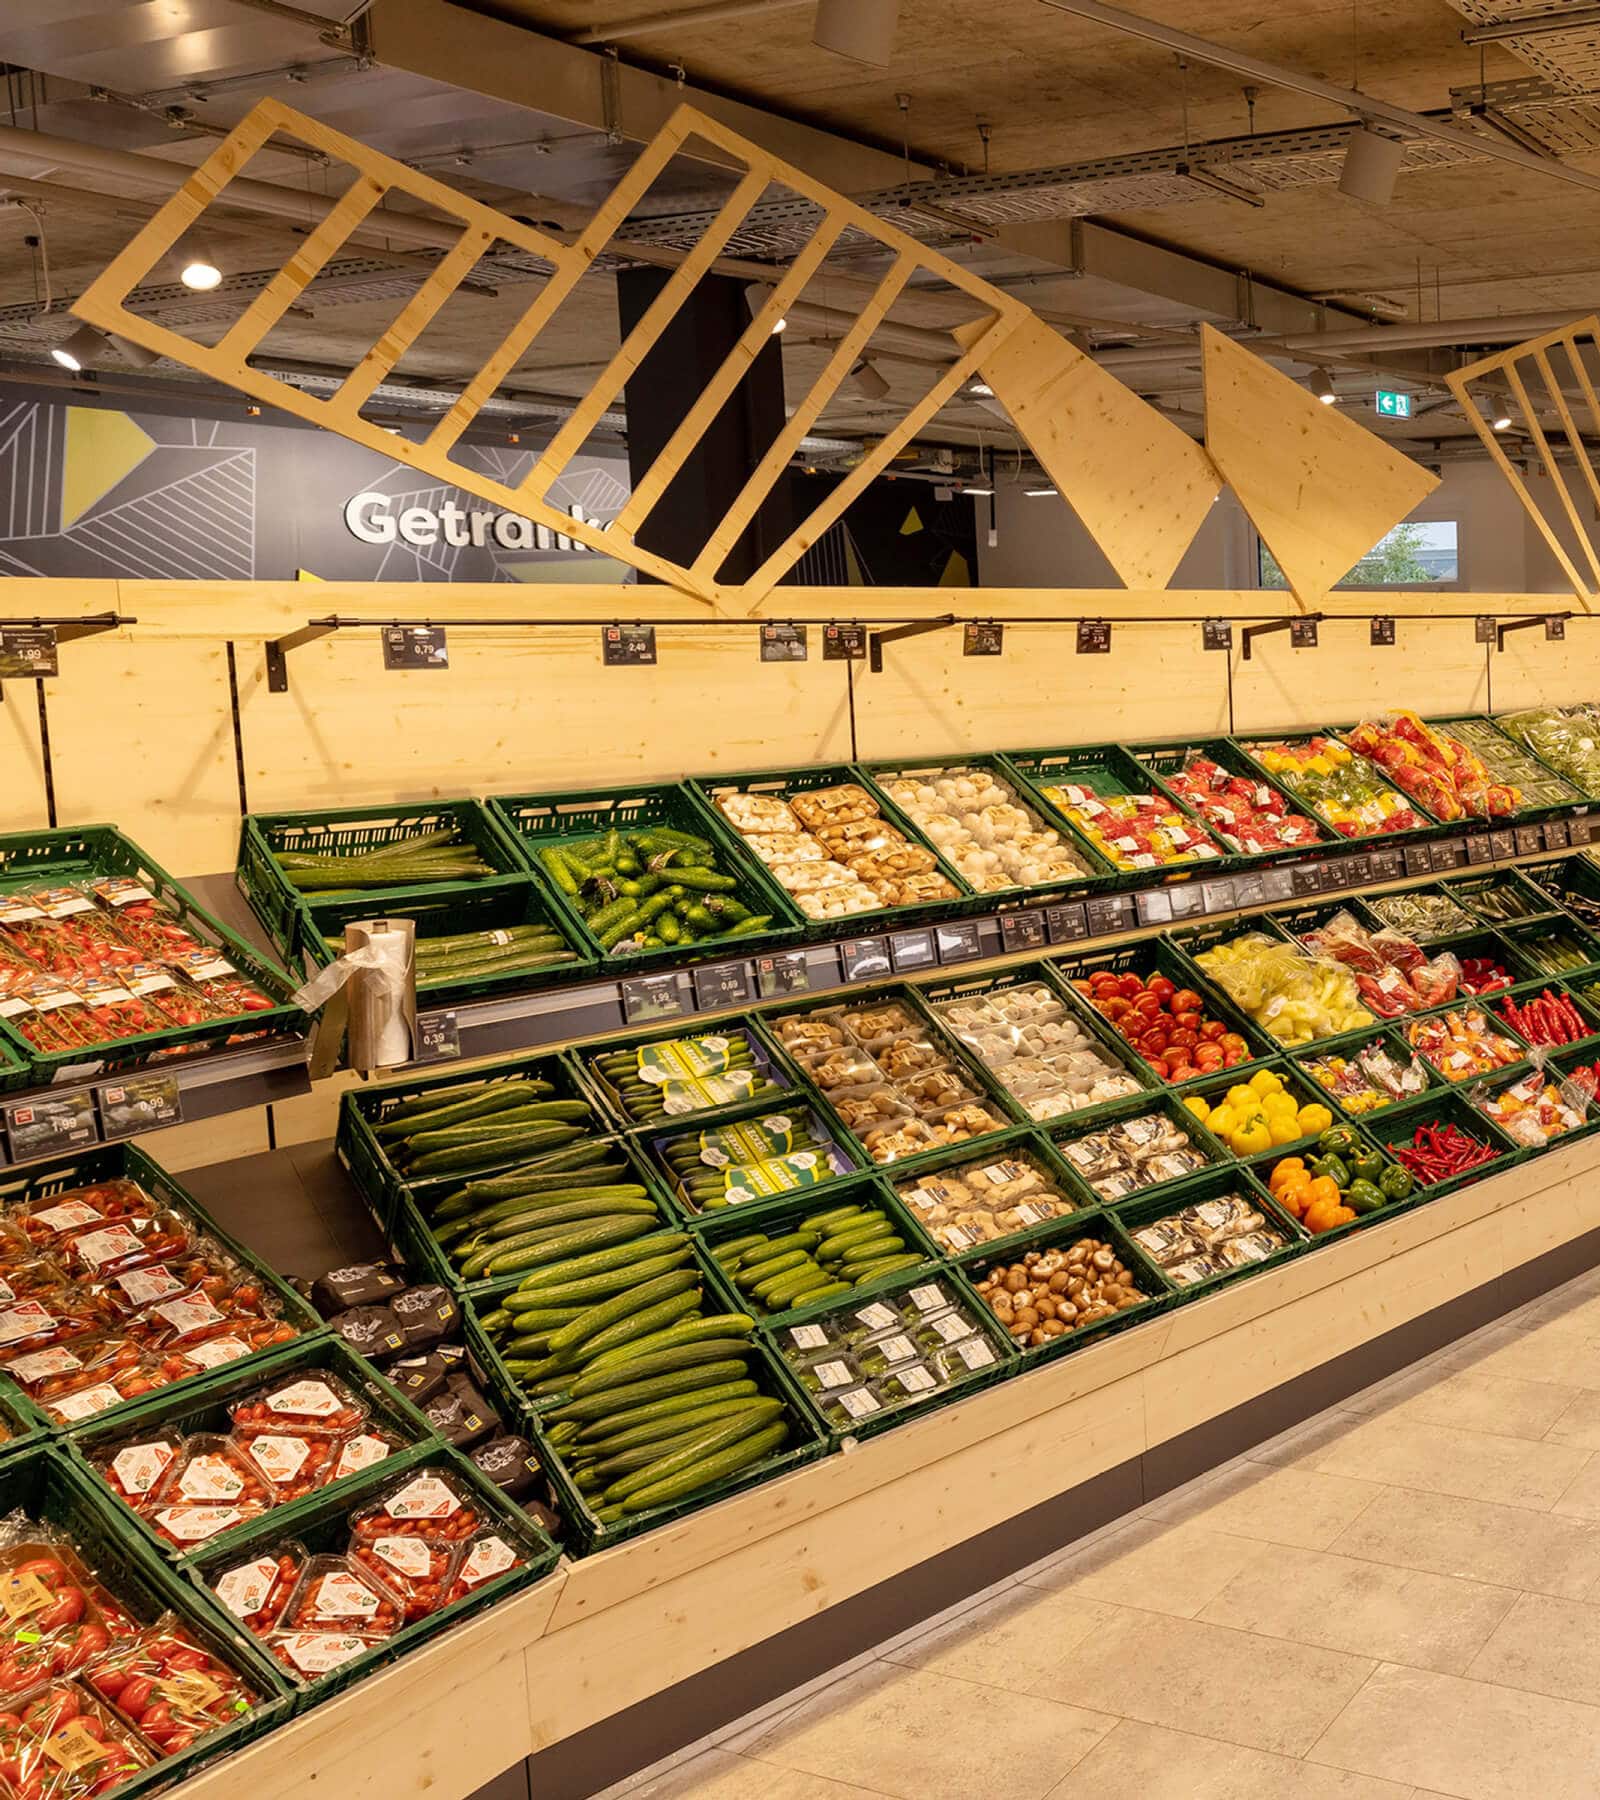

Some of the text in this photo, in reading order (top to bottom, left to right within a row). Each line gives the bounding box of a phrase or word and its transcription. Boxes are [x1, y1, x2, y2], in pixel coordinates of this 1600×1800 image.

[17, 649, 41, 661] 1,99
[423, 1033, 445, 1045] 0,39
[140, 1097, 164, 1112] 0,99
[52, 1117, 77, 1132] 1,99
